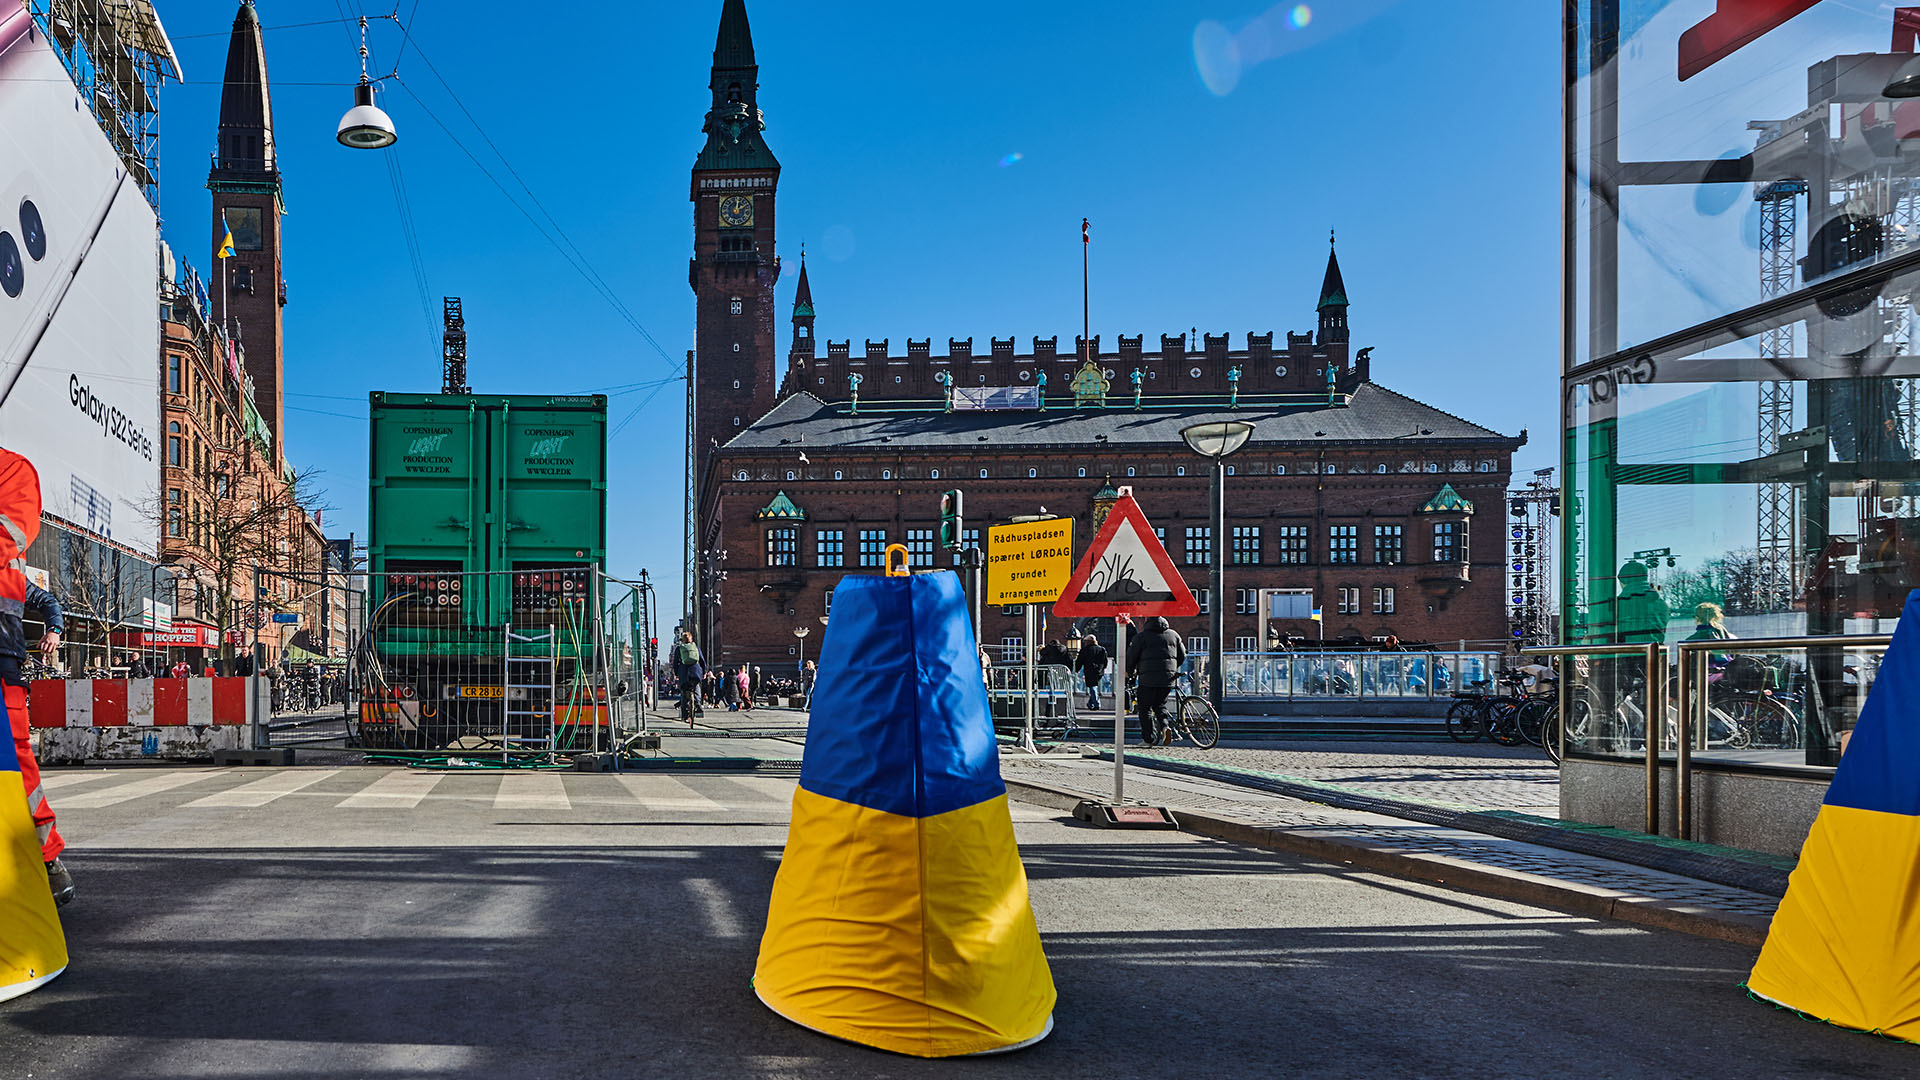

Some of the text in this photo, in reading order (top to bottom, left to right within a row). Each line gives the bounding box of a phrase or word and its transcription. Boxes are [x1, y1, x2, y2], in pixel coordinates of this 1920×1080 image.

[69, 373, 152, 462] Galaxy S22 Series
[402, 426, 453, 435] COPENHAGEN
[402, 456, 453, 464] PRODUCTION
[994, 530, 1064, 543] Rådhuspladsen
[990, 547, 1070, 563] spærret LØRDAG
[1011, 569, 1046, 581] grundet
[1000, 587, 1057, 599] arrangement
[144, 633, 197, 642] WHOPPER
[465, 687, 502, 696] CR 28 16
